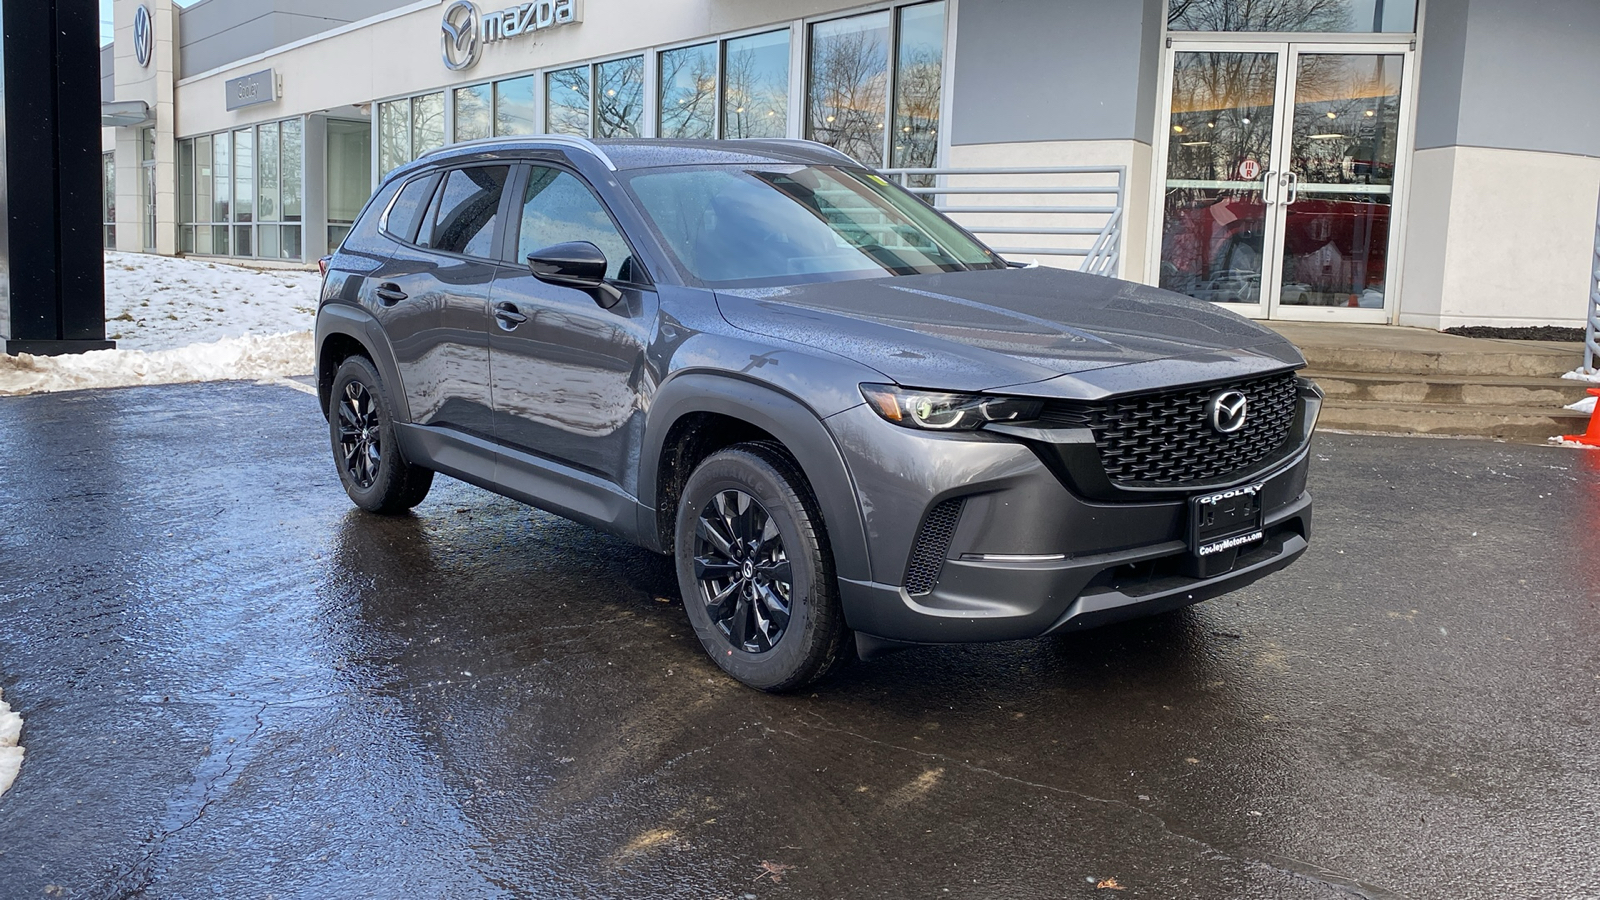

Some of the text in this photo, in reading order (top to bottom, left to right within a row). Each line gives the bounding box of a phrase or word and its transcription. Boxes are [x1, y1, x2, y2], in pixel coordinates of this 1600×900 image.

[482, 0, 575, 43] mazda
[1200, 484, 1264, 504] COOLEY
[1199, 531, 1263, 556] CooleyMotors.com
